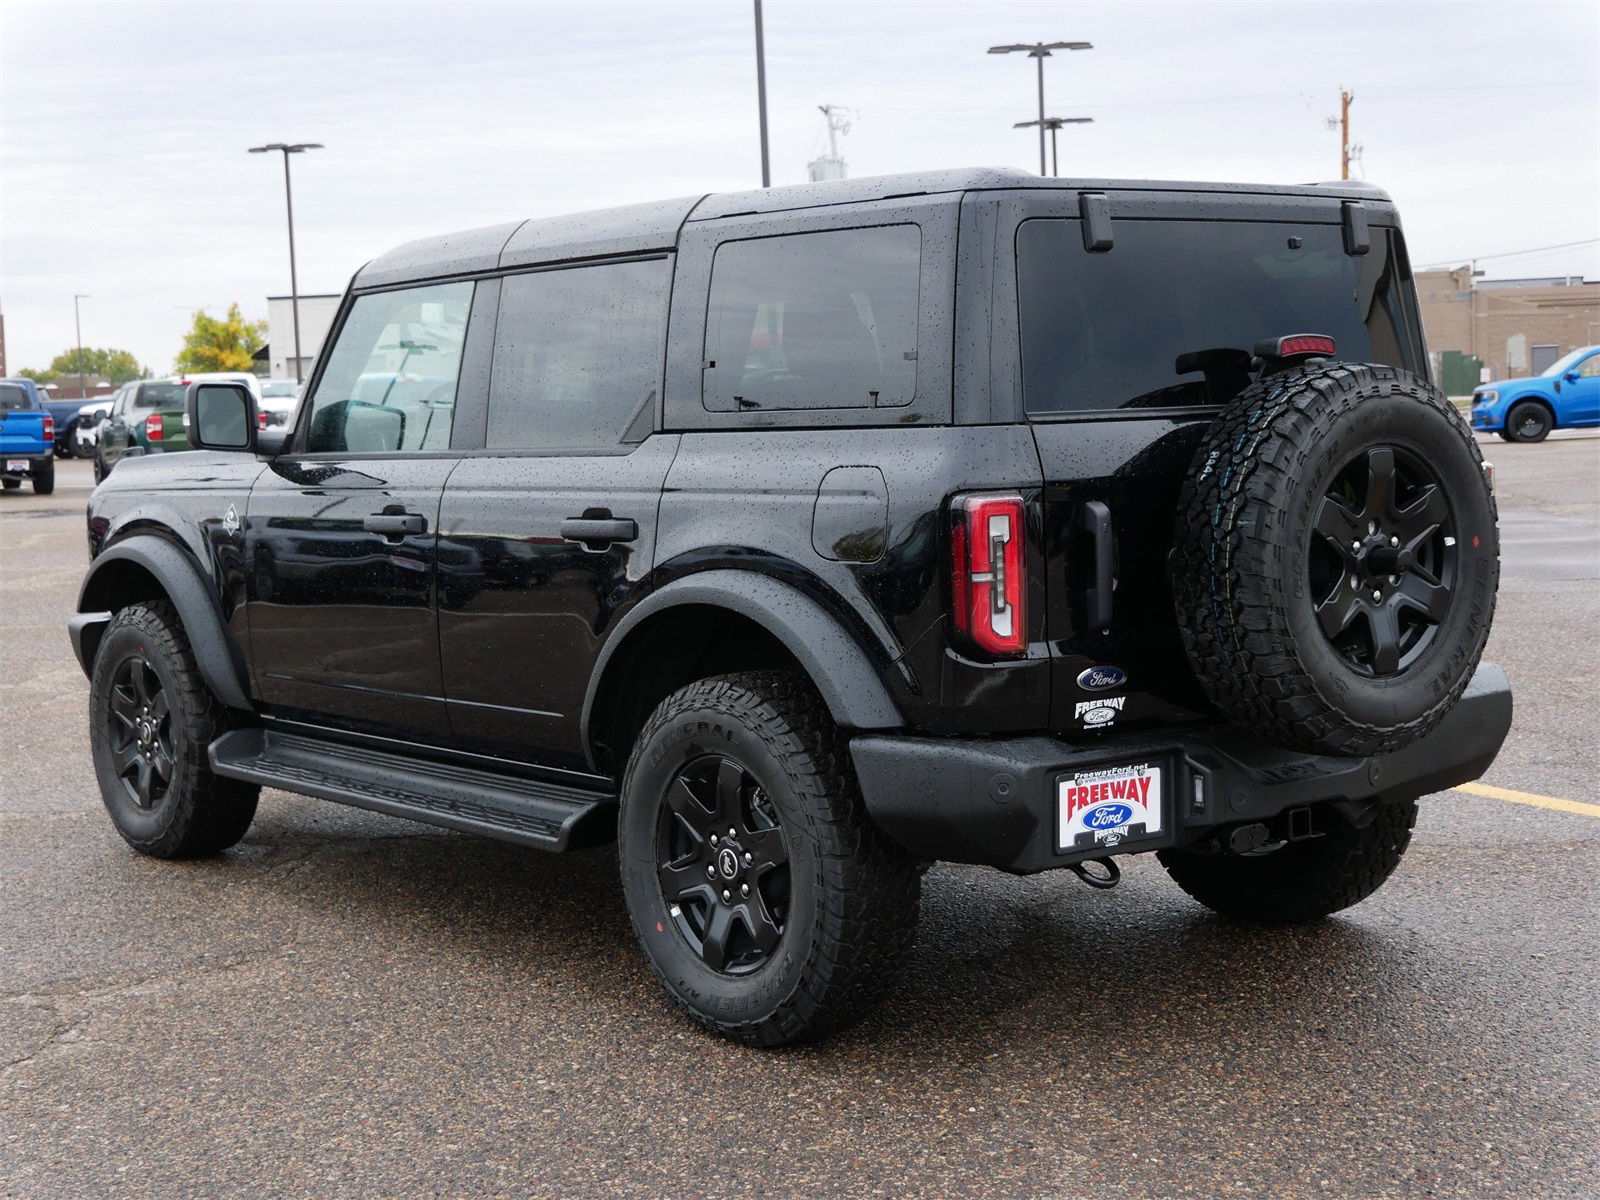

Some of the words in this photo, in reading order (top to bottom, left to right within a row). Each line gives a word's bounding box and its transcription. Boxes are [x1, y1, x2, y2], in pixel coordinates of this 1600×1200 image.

[1089, 671, 1117, 687] Ford
[1074, 696, 1126, 720] FREEWAY
[649, 721, 739, 770] GENERAL
[1074, 762, 1149, 780] FreewayFord.net
[1067, 776, 1152, 824] FREEWAY
[1091, 806, 1125, 827] Ford
[1094, 825, 1130, 843] FREEWAY
